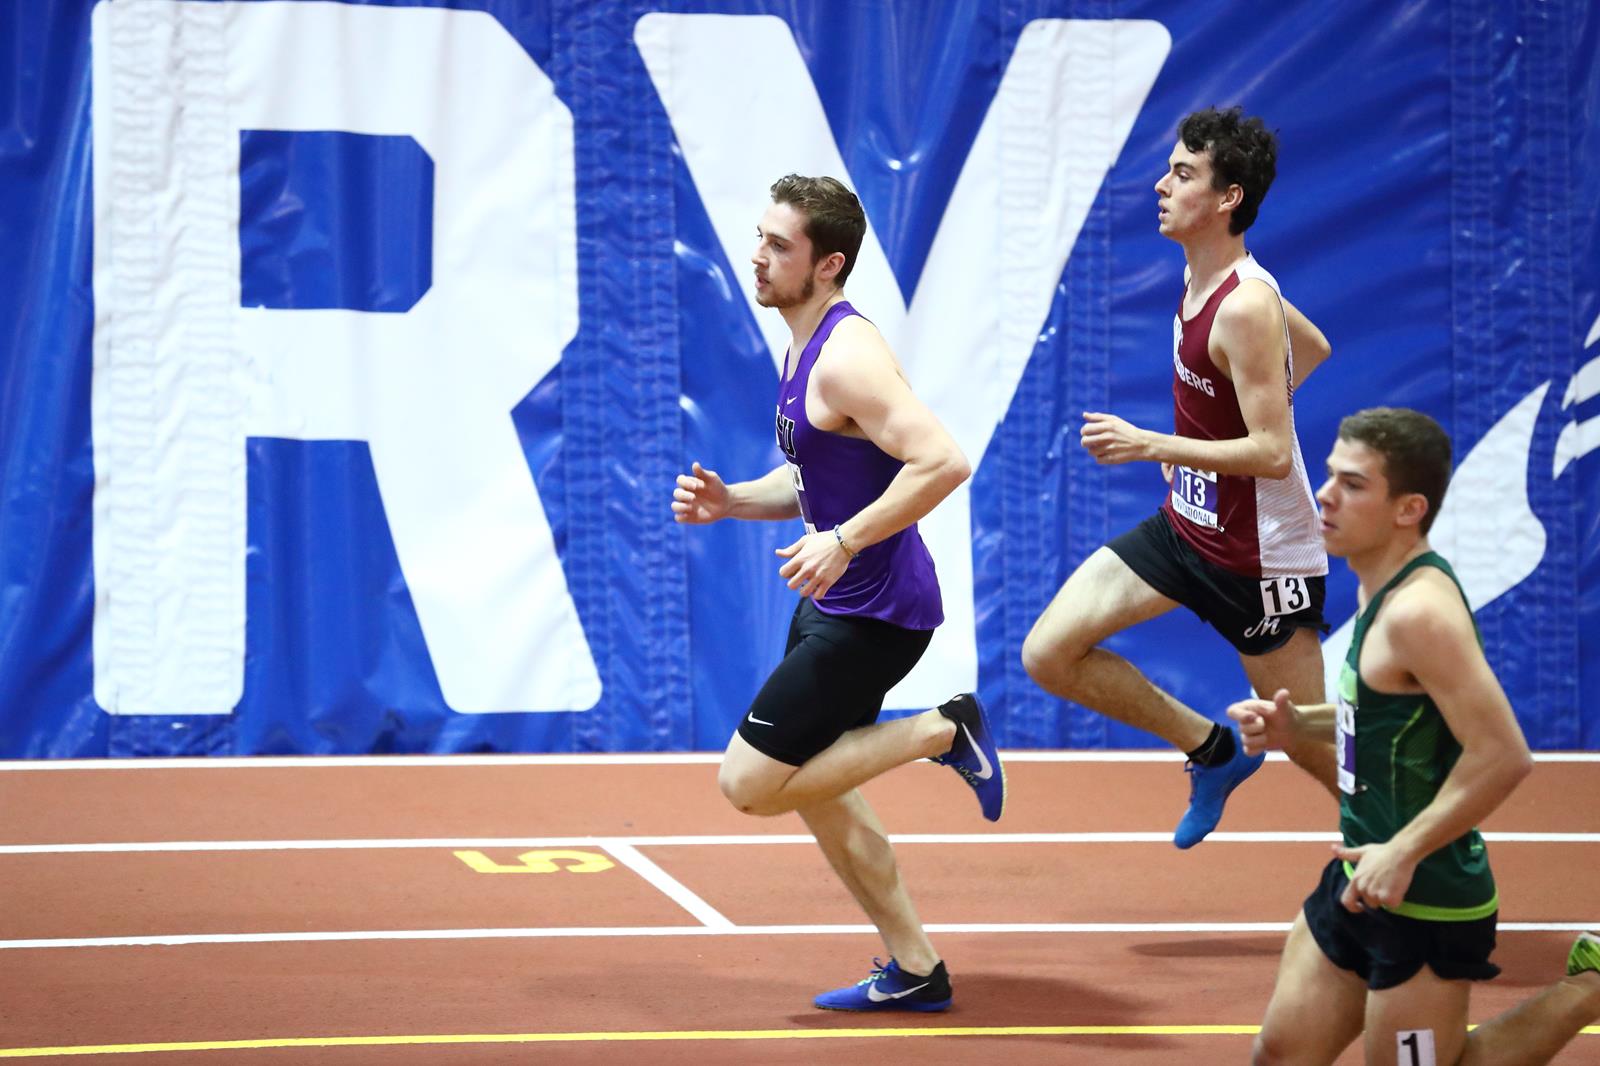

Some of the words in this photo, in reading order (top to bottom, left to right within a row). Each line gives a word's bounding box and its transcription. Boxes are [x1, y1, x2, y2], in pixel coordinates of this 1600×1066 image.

[1175, 357, 1215, 398] BERG
[1265, 577, 1304, 613] 13
[452, 850, 616, 873] 5
